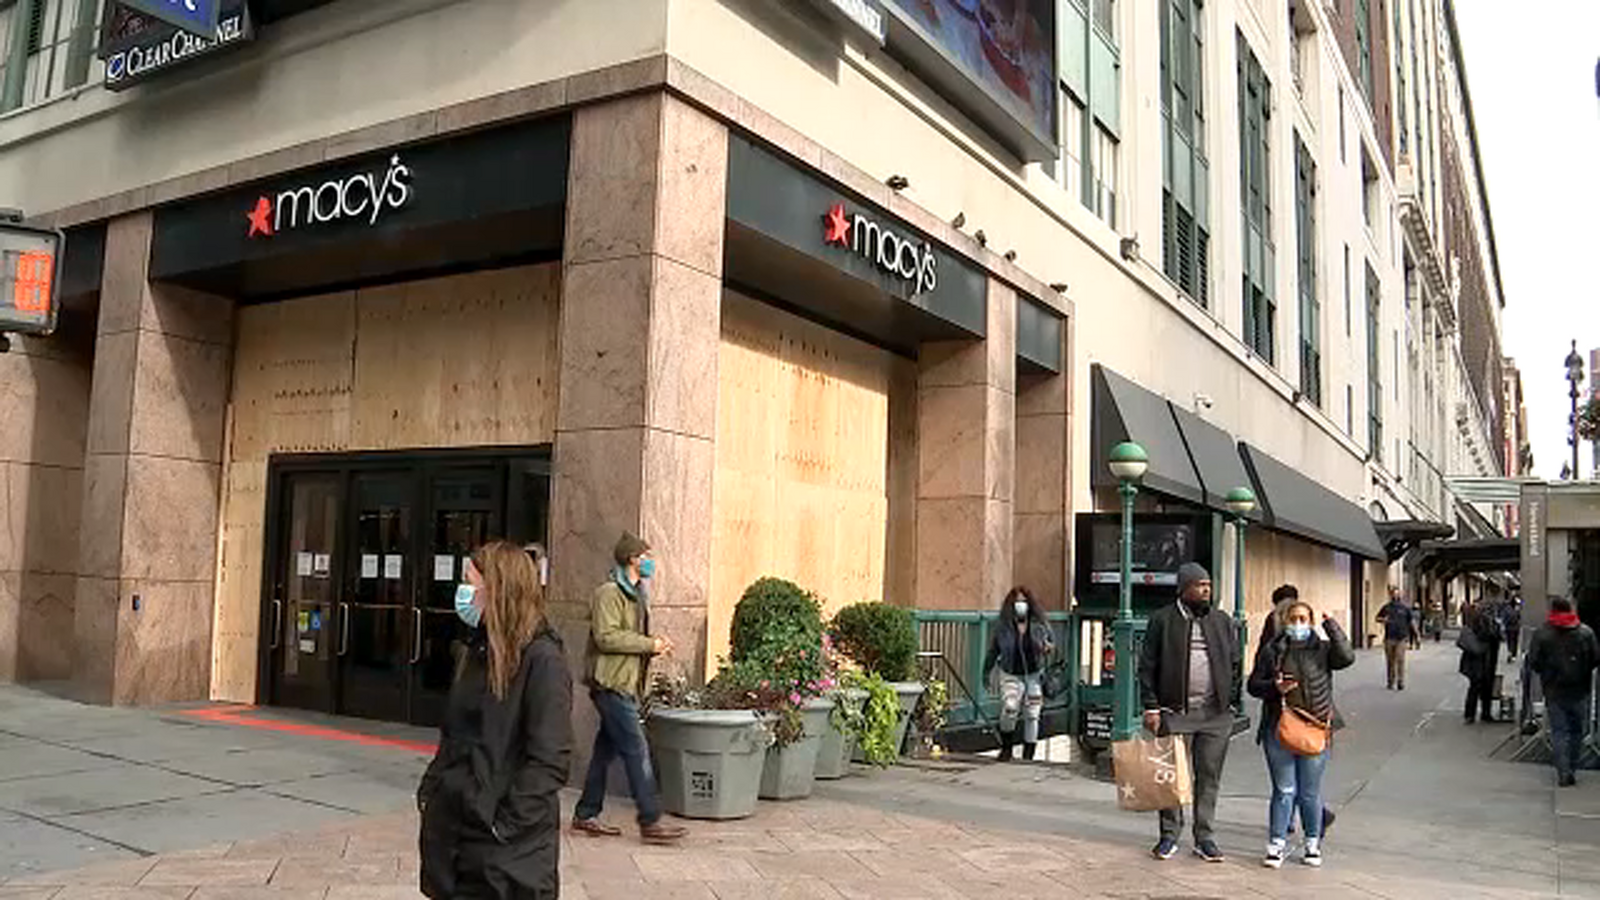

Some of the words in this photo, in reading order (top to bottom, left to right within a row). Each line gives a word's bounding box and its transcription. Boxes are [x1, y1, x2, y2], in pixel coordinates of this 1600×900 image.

[126, 46, 171, 76] CLEAR
[171, 16, 243, 60] CHANEL
[274, 153, 409, 231] macy's
[853, 213, 936, 295] macy's
